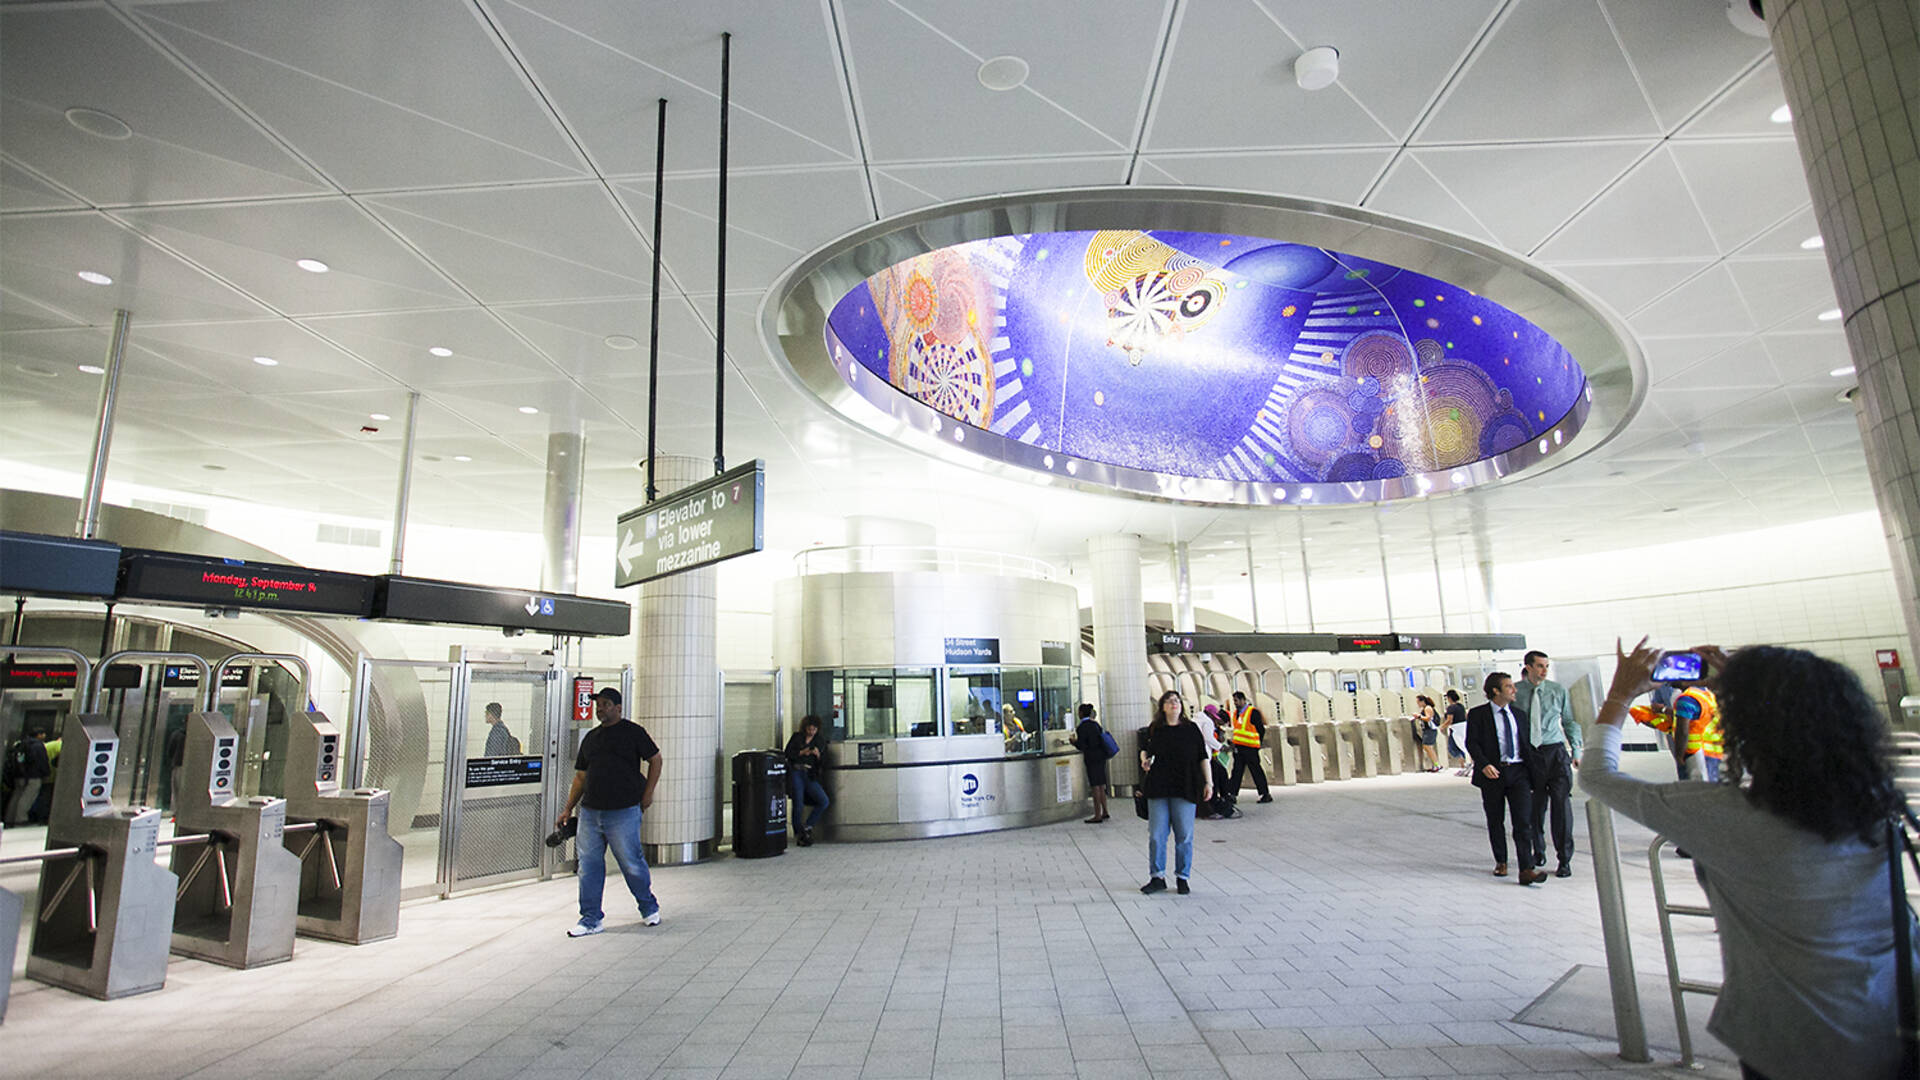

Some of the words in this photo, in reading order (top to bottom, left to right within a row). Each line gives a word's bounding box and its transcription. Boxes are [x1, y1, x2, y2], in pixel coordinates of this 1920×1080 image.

[658, 497, 706, 529] Elevator
[711, 489, 726, 510] to
[658, 531, 674, 550] via
[678, 519, 713, 545] lower
[656, 540, 721, 573] mezzanine
[202, 572, 248, 588] Monday,
[251, 576, 306, 591] September
[945, 648, 973, 656] Hudson
[973, 648, 992, 656] Yards
[1162, 635, 1180, 645] Entry
